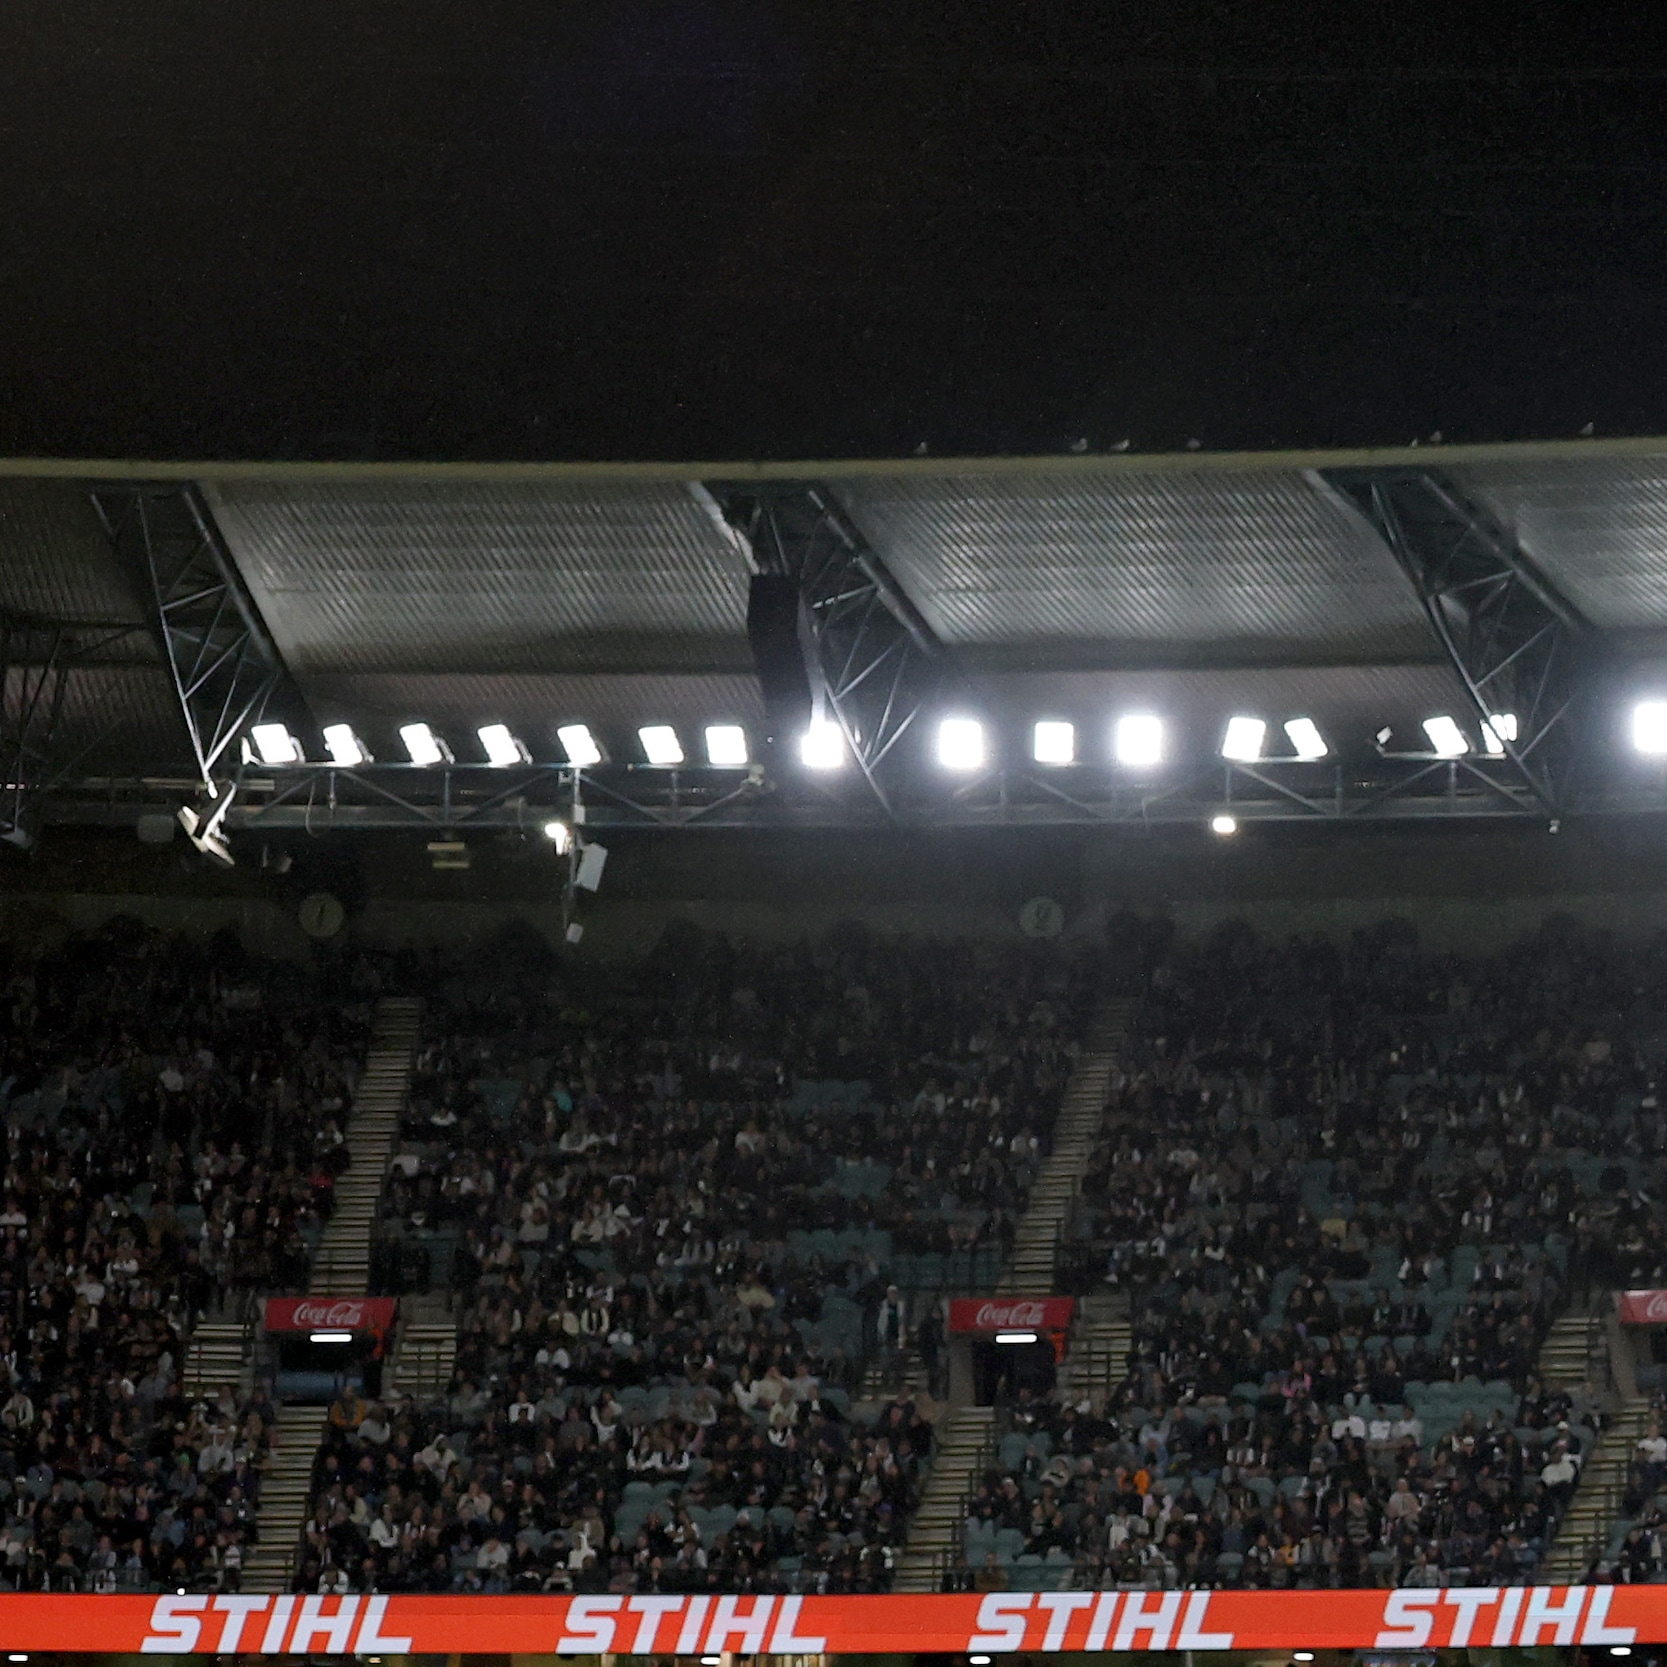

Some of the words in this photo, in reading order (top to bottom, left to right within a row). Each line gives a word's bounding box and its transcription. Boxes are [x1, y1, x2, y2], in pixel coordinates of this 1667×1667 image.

[141, 1595, 412, 1653] STIHL
[557, 1596, 825, 1653] STIHL
[968, 1591, 1233, 1651] STIHL
[1375, 1586, 1636, 1647] STIHL
